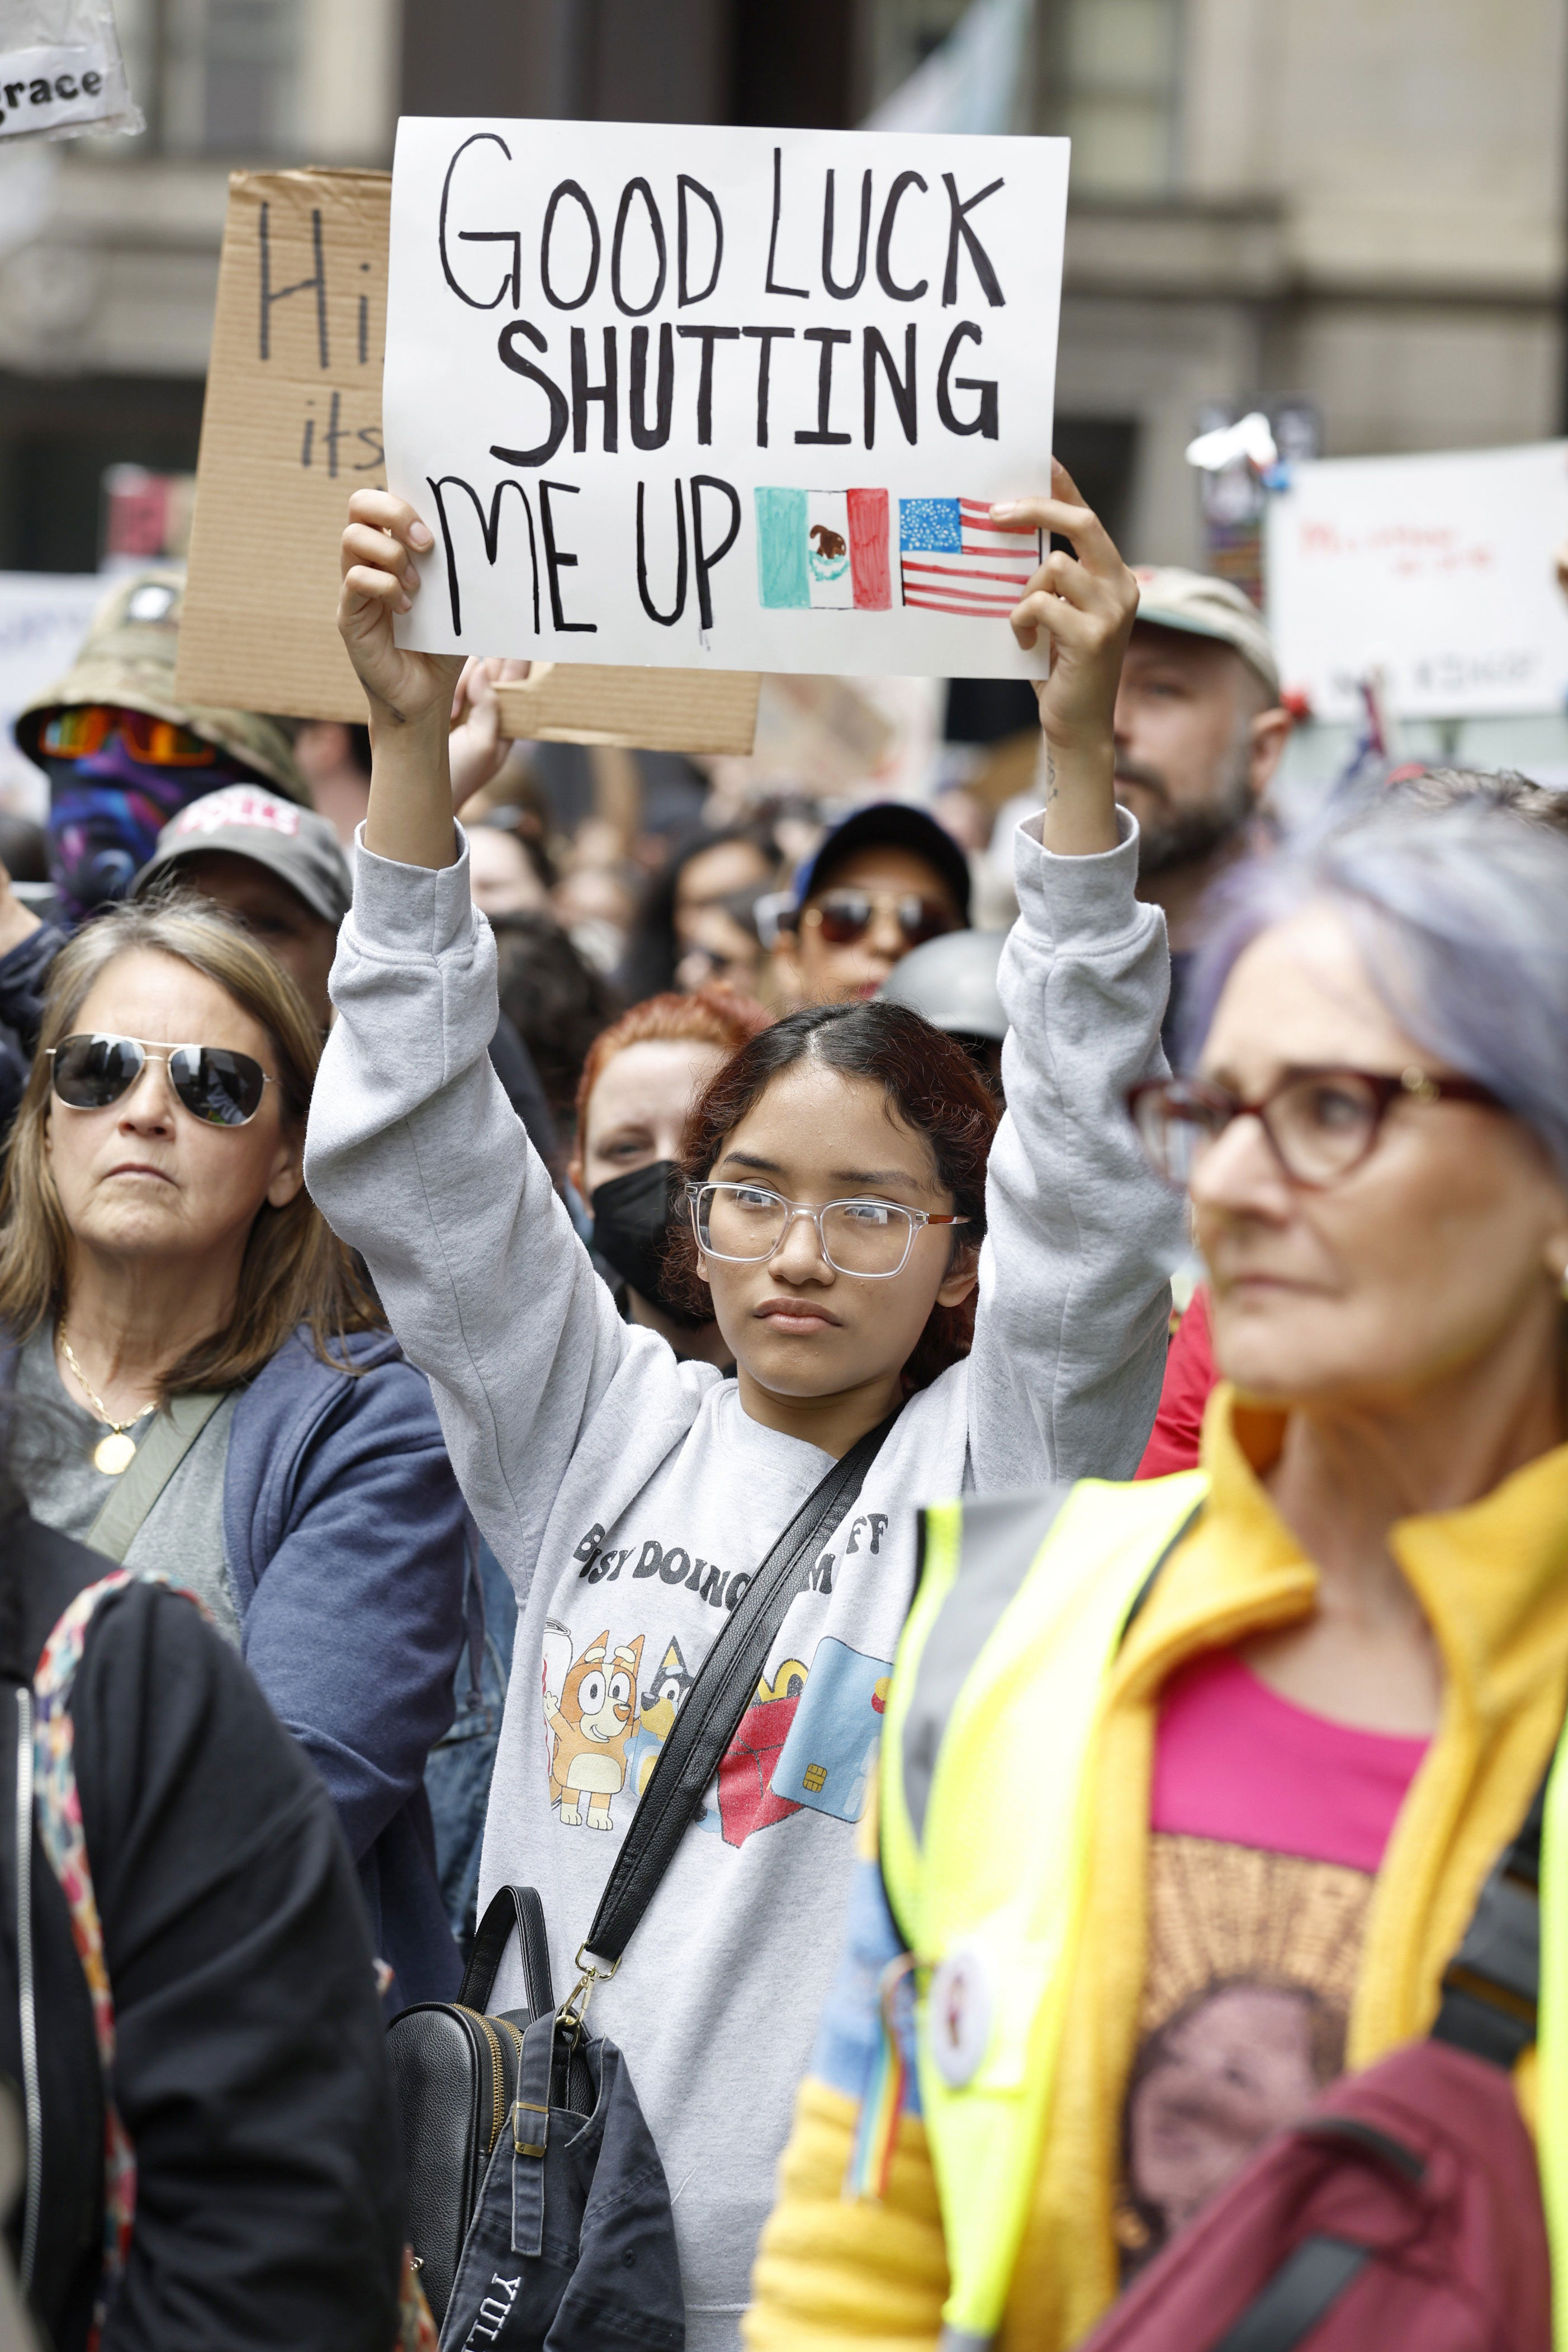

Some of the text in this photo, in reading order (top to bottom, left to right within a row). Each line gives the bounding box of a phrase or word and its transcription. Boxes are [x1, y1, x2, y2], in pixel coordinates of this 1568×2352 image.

[0, 70, 103, 126] race
[438, 132, 1006, 318] GOOD LUCK
[488, 319, 999, 468] SHUTTING
[425, 474, 742, 637] ME UP
[461, 2272, 522, 2352] YUL
